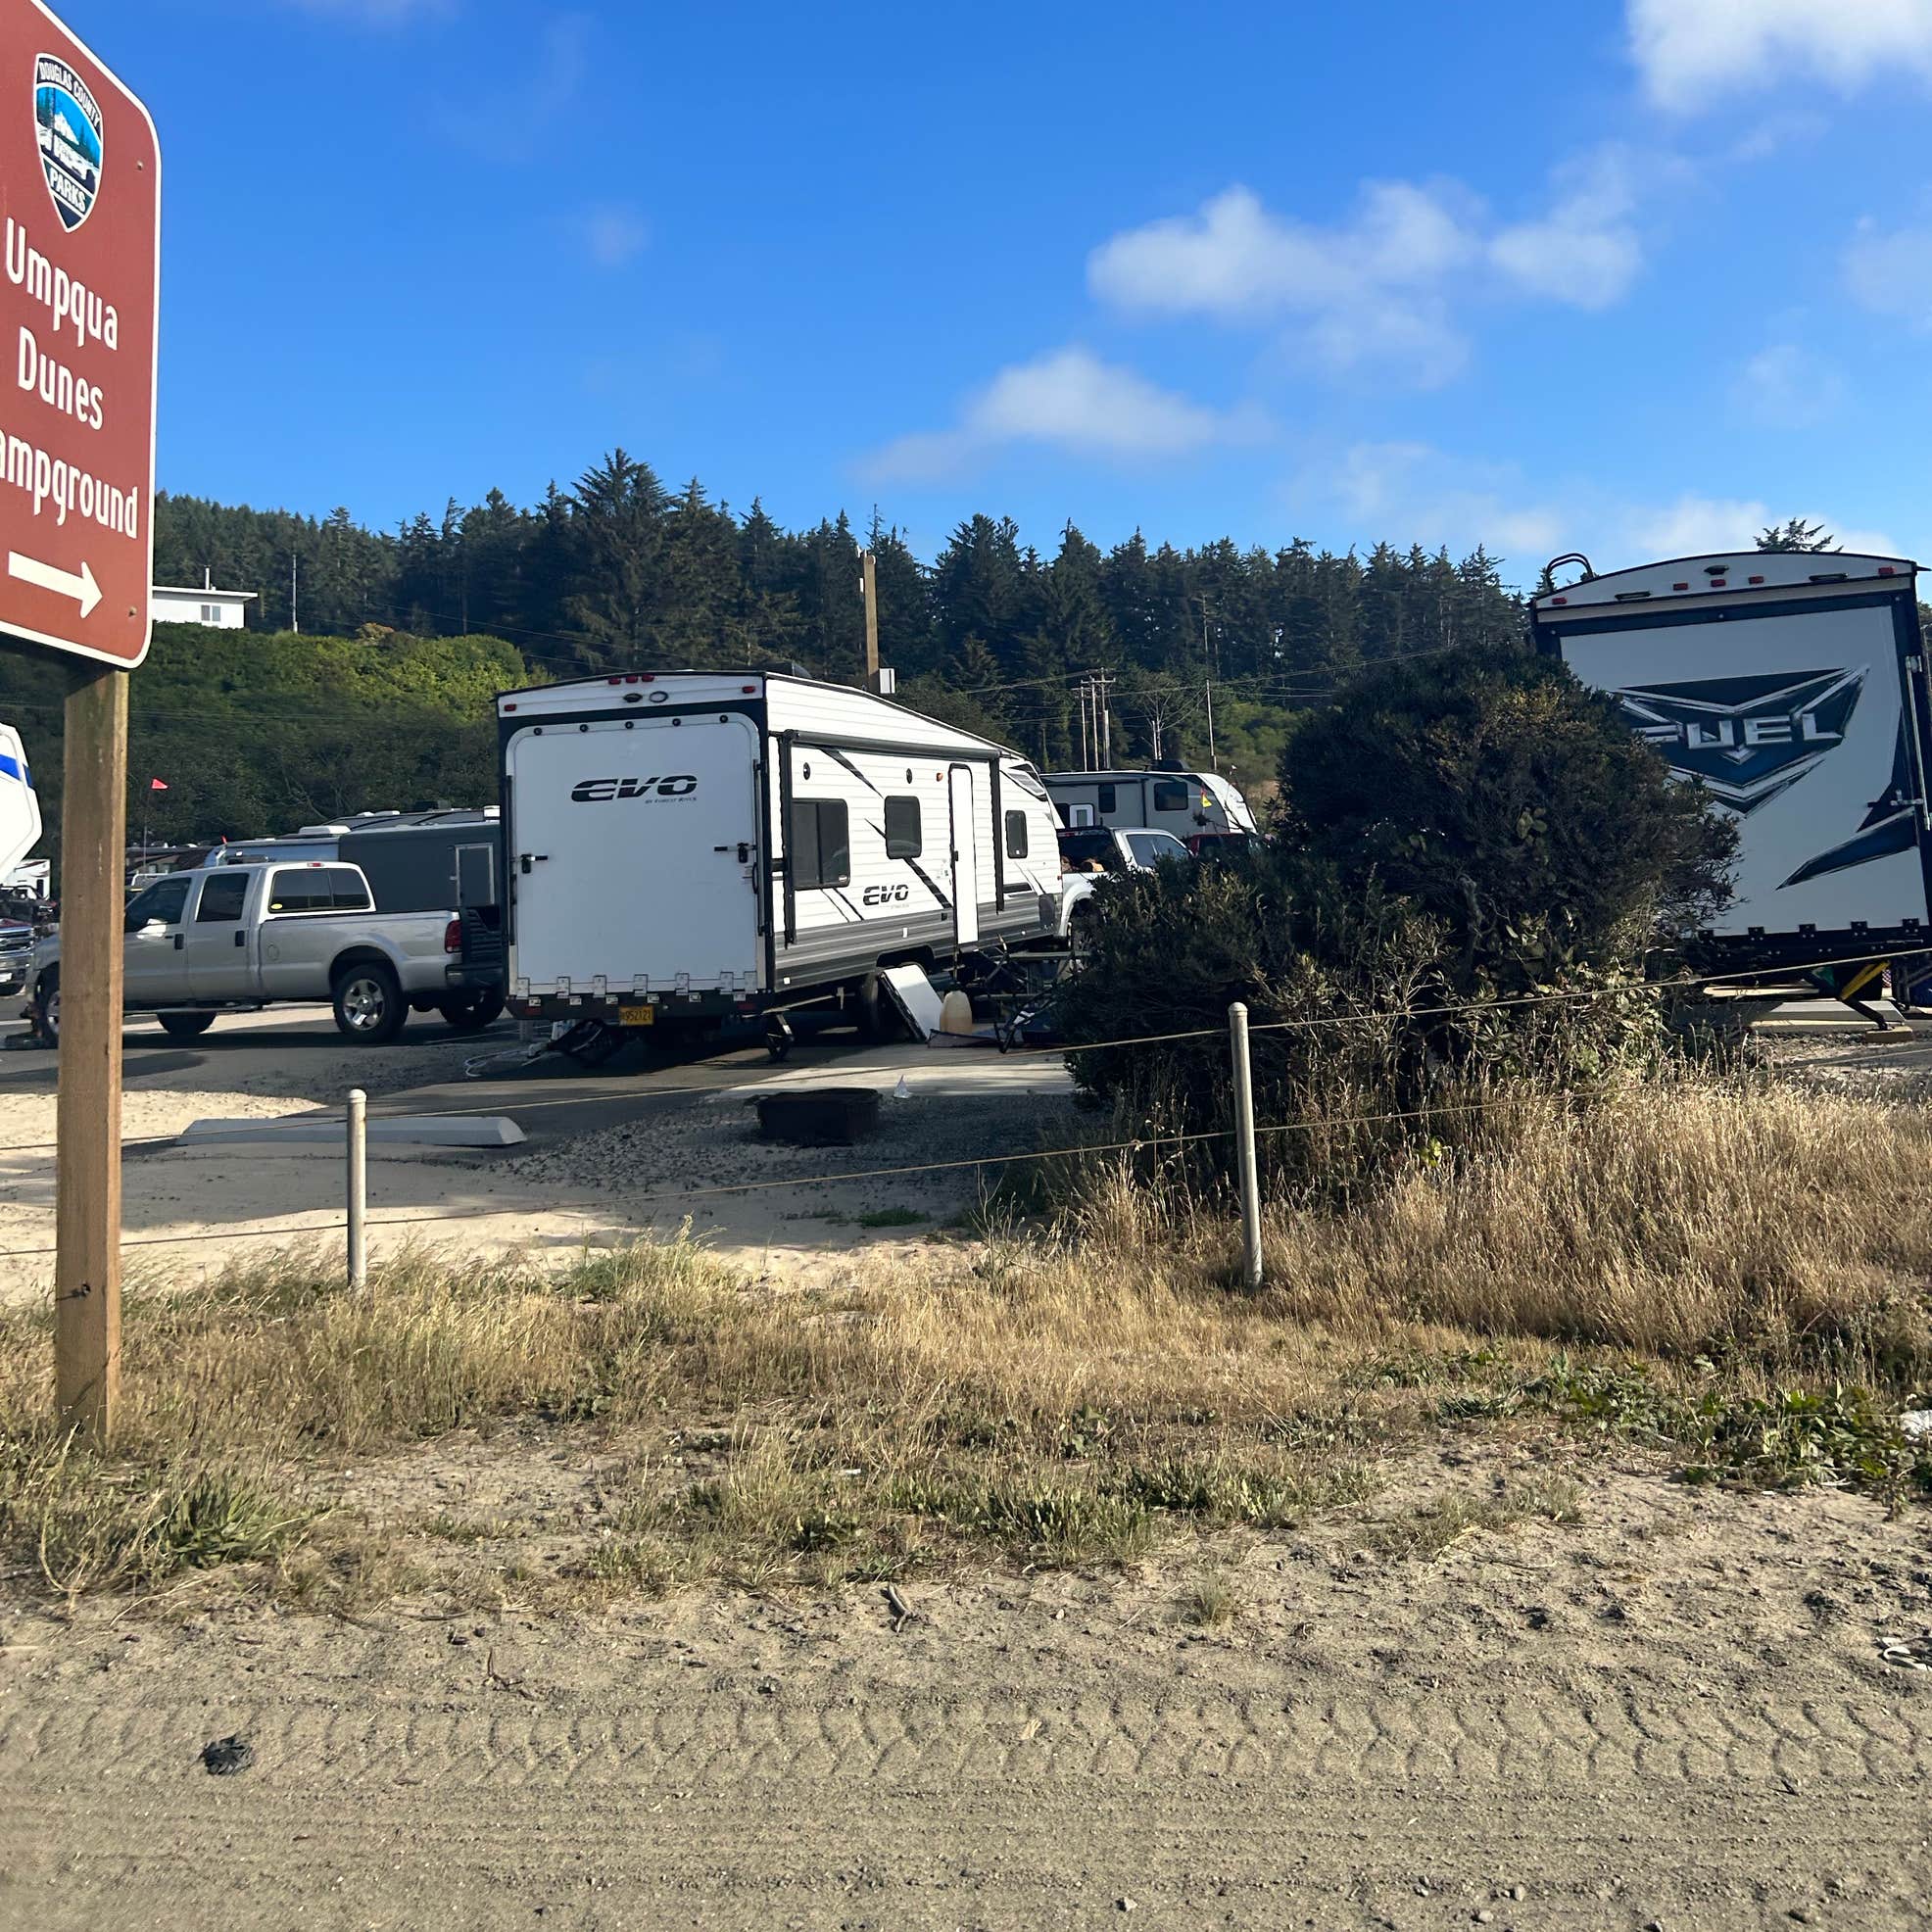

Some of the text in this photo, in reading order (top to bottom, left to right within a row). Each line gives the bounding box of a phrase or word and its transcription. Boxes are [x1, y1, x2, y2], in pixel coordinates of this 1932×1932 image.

[38, 61, 101, 127] DOUGLAS COUNTY
[50, 167, 87, 213] PARKS
[6, 217, 119, 351] Umpqua
[18, 325, 104, 431] Dunes
[570, 774, 699, 802] EVO
[862, 884, 909, 906] EVO
